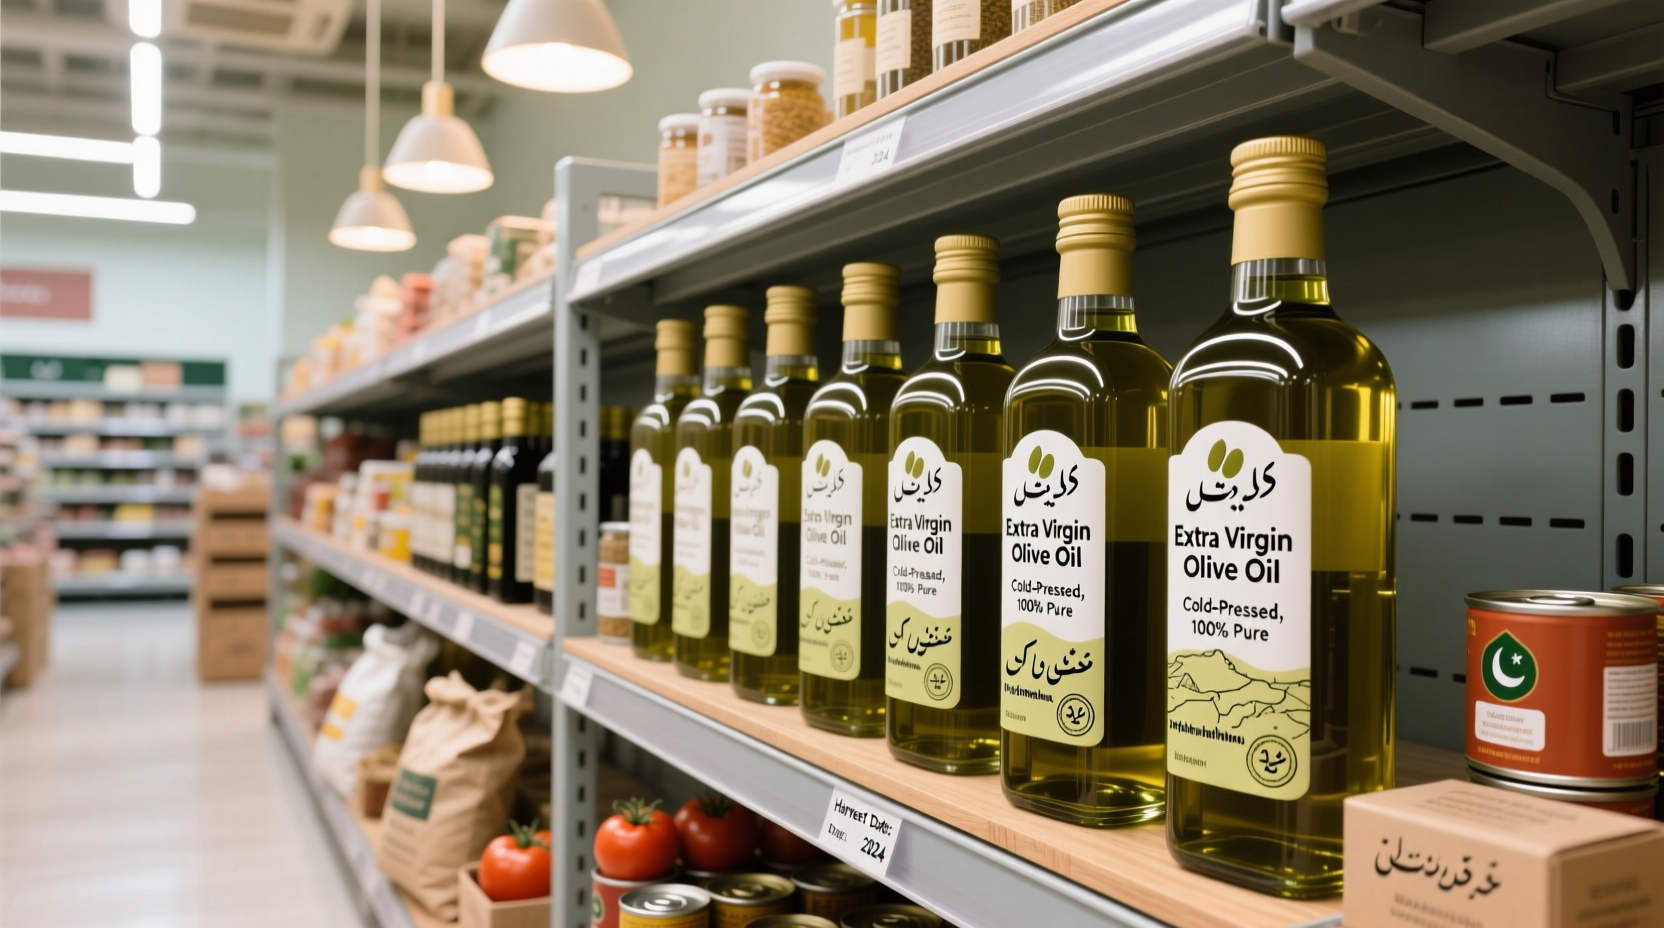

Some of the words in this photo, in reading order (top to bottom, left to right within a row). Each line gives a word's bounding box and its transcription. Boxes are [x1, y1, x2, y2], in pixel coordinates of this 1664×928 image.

[1006, 518, 1039, 538] Extra
[1042, 519, 1091, 545] Virgin
[1174, 525, 1220, 549] Extra
[1224, 526, 1293, 557] Virgin
[923, 536, 944, 555] Oil
[1011, 543, 1051, 565] Olive
[1055, 546, 1082, 568] Oil
[1183, 554, 1238, 581] Olive
[1245, 558, 1280, 584] Oil
[917, 583, 937, 596] Pure
[1017, 598, 1043, 614] 100%
[1047, 602, 1073, 618] Pure
[1183, 596, 1284, 624] Cold-Pressed,
[1191, 619, 1229, 638] 100%
[1234, 623, 1270, 641] Pure
[860, 836, 887, 863] 2024
